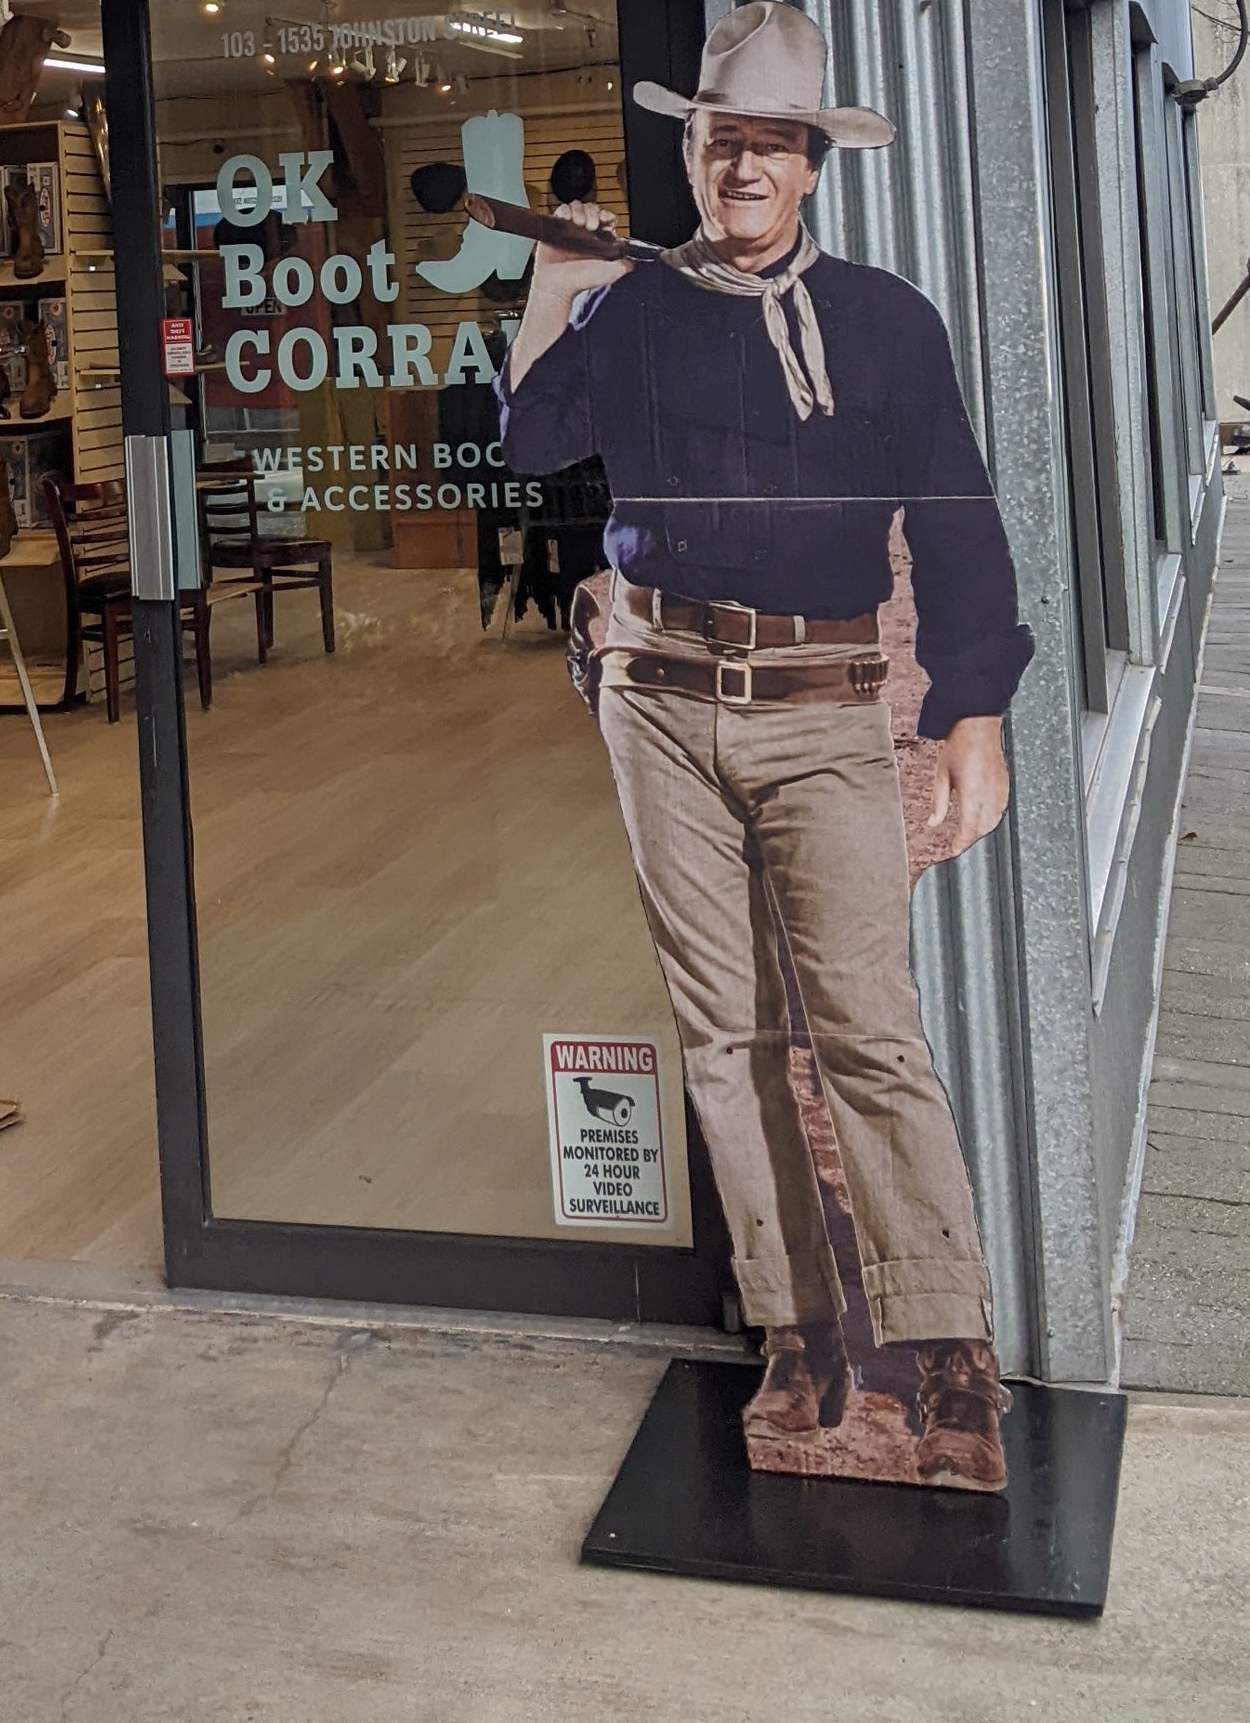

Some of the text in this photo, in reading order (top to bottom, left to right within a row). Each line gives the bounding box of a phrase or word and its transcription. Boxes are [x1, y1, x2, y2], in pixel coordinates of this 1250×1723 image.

[221, 31, 256, 58] 103
[277, 25, 326, 54] 1535
[330, 15, 437, 49] JOHNSTON
[216, 149, 339, 228] OK
[219, 238, 399, 308] Boot
[252, 443, 418, 473] WESTERN
[267, 481, 544, 513] & ACCESSORIES
[555, 1044, 654, 1072] WARNING
[580, 1128, 639, 1145] PREMISES
[563, 1146, 659, 1164] MONITORED BY
[584, 1164, 641, 1180] 24 HOUR
[593, 1181, 633, 1197] VIDEO
[569, 1198, 660, 1216] SURVEILLANCE
